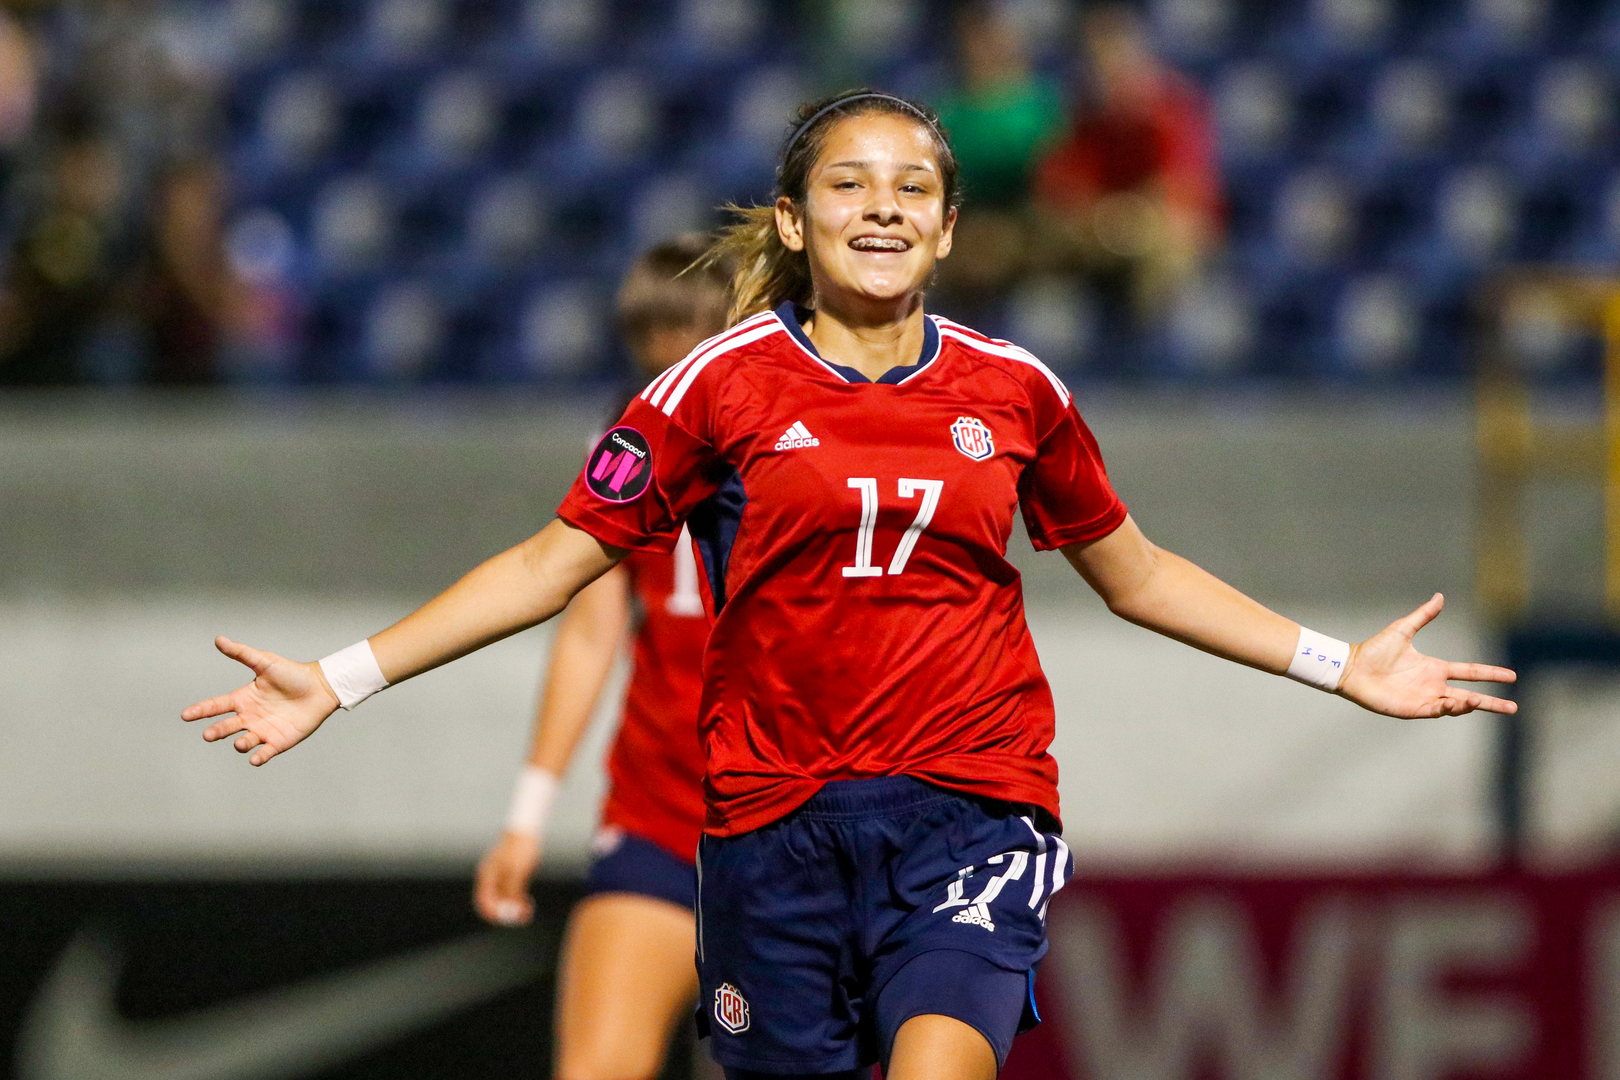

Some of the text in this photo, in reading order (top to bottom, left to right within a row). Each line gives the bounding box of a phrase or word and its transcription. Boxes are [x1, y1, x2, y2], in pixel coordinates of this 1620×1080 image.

[612, 432, 646, 459] Concacaf
[774, 436, 820, 451] adidas
[960, 426, 985, 453] CR
[842, 477, 944, 577] 17
[932, 850, 1030, 914] 17
[952, 913, 995, 933] adidas
[723, 992, 743, 1025] CR
